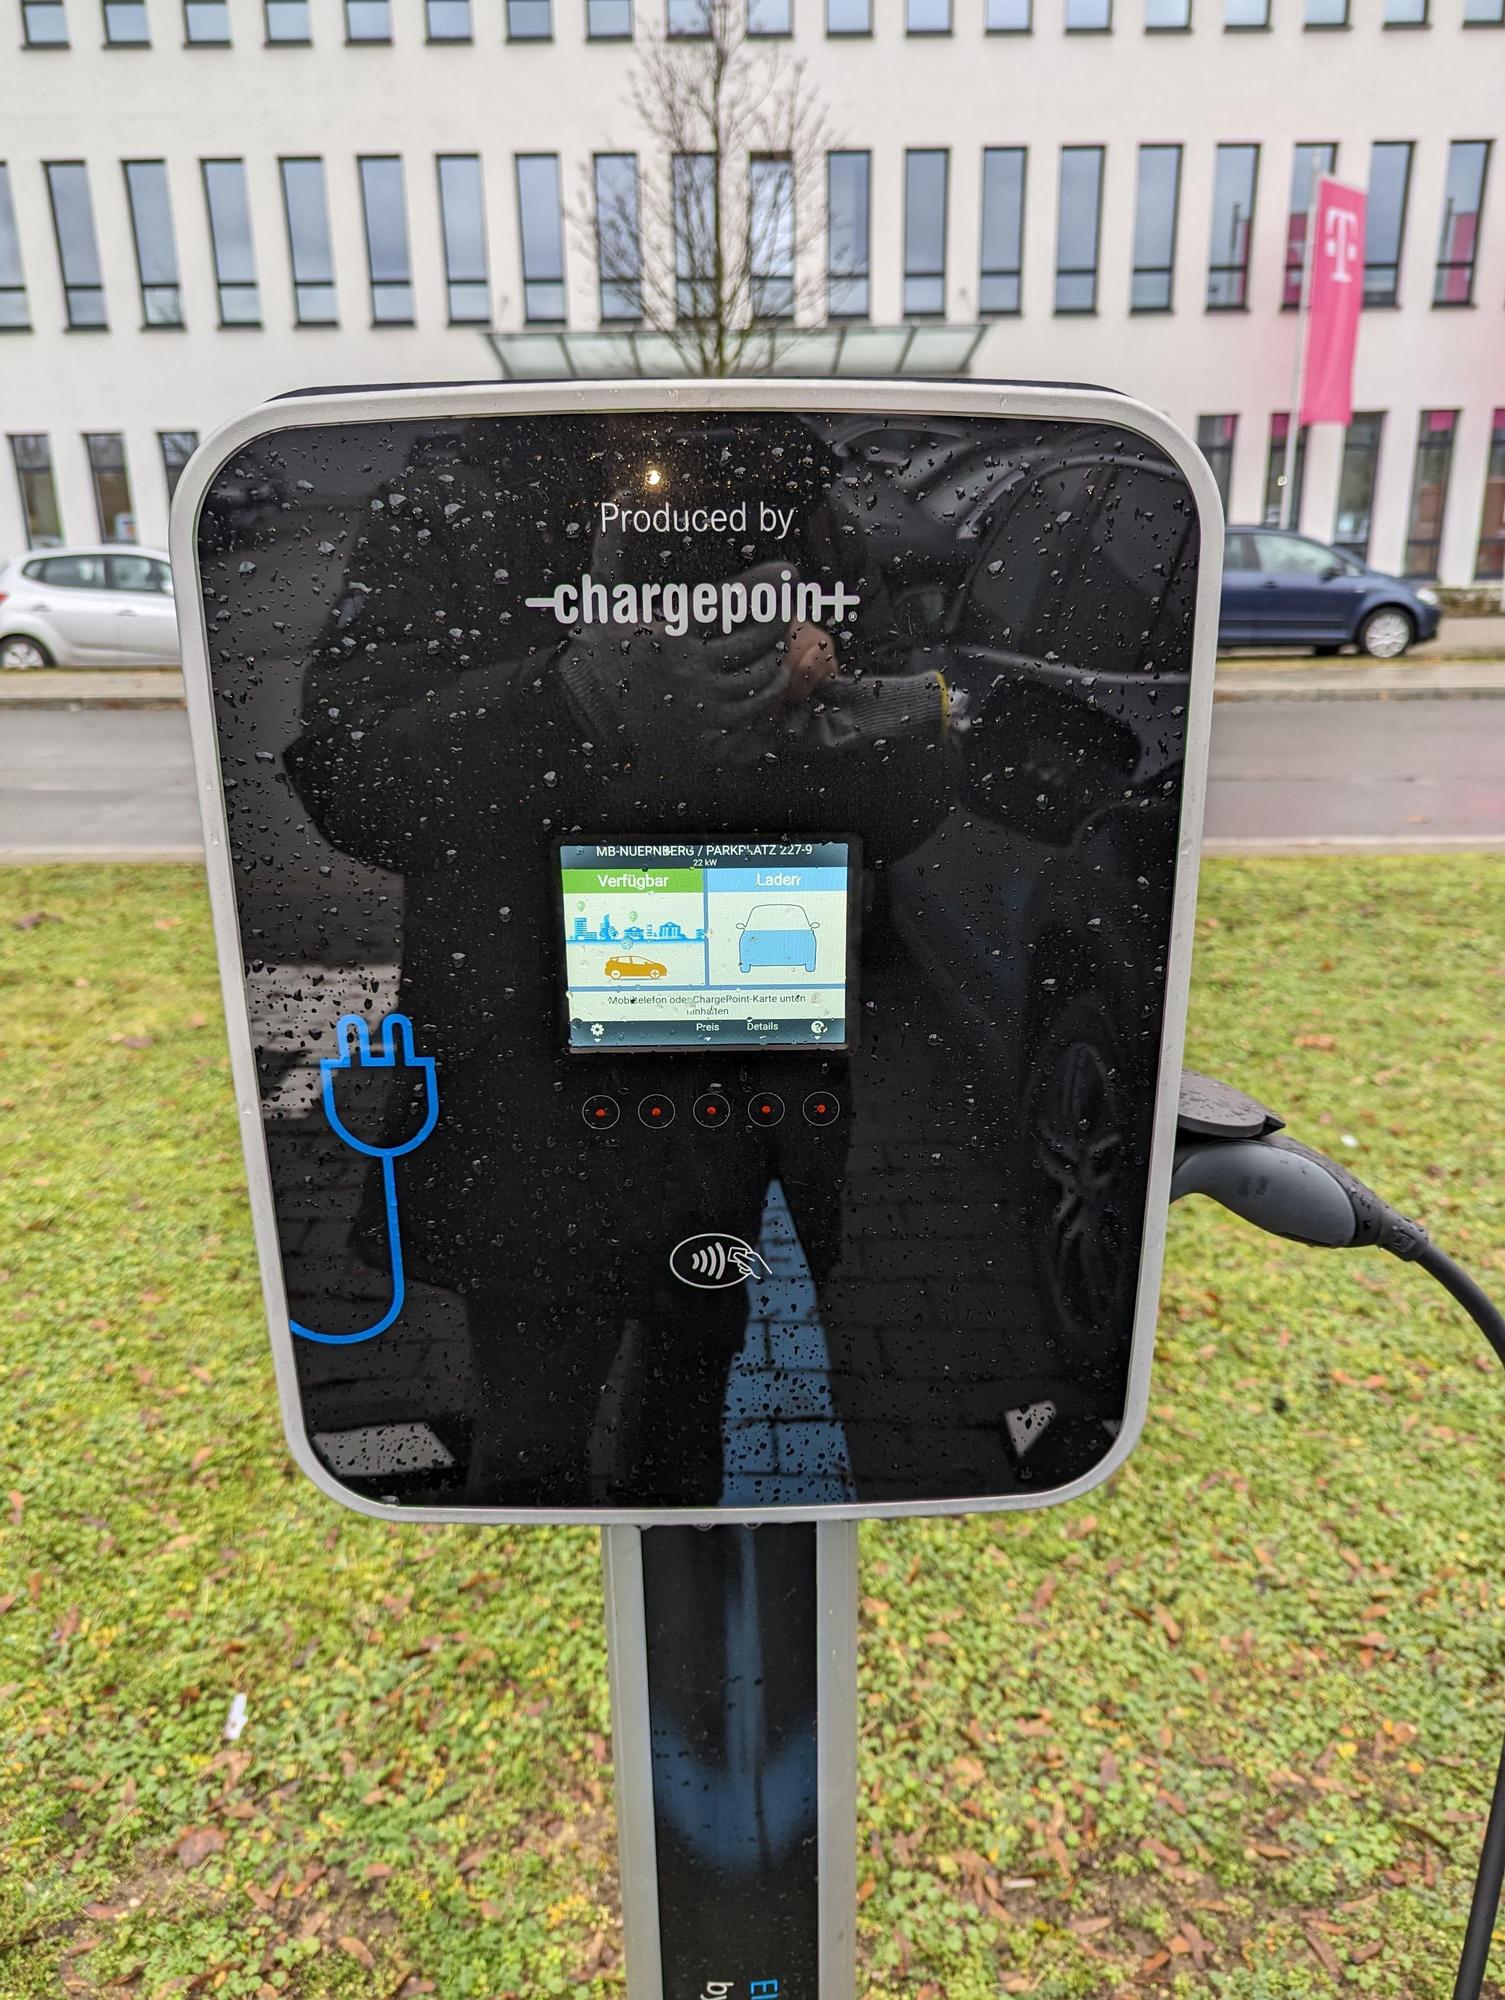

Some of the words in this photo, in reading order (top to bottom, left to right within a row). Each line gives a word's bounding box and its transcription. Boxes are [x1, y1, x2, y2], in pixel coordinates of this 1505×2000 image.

[1325, 207, 1358, 283] T
[601, 502, 746, 533] Produced
[760, 502, 794, 540] by
[596, 845, 695, 857] MB-NUERNBERG
[706, 844, 777, 856] PARKPLATZ
[779, 844, 813, 855] 227-9
[693, 858, 704, 867] 22
[704, 858, 718, 867] kW
[597, 873, 669, 890] Verfügbar
[692, 994, 778, 1005] ChargePoint-Karte
[780, 994, 806, 1003] unten
[696, 1022, 720, 1032] Preis
[747, 1021, 779, 1031] Details
